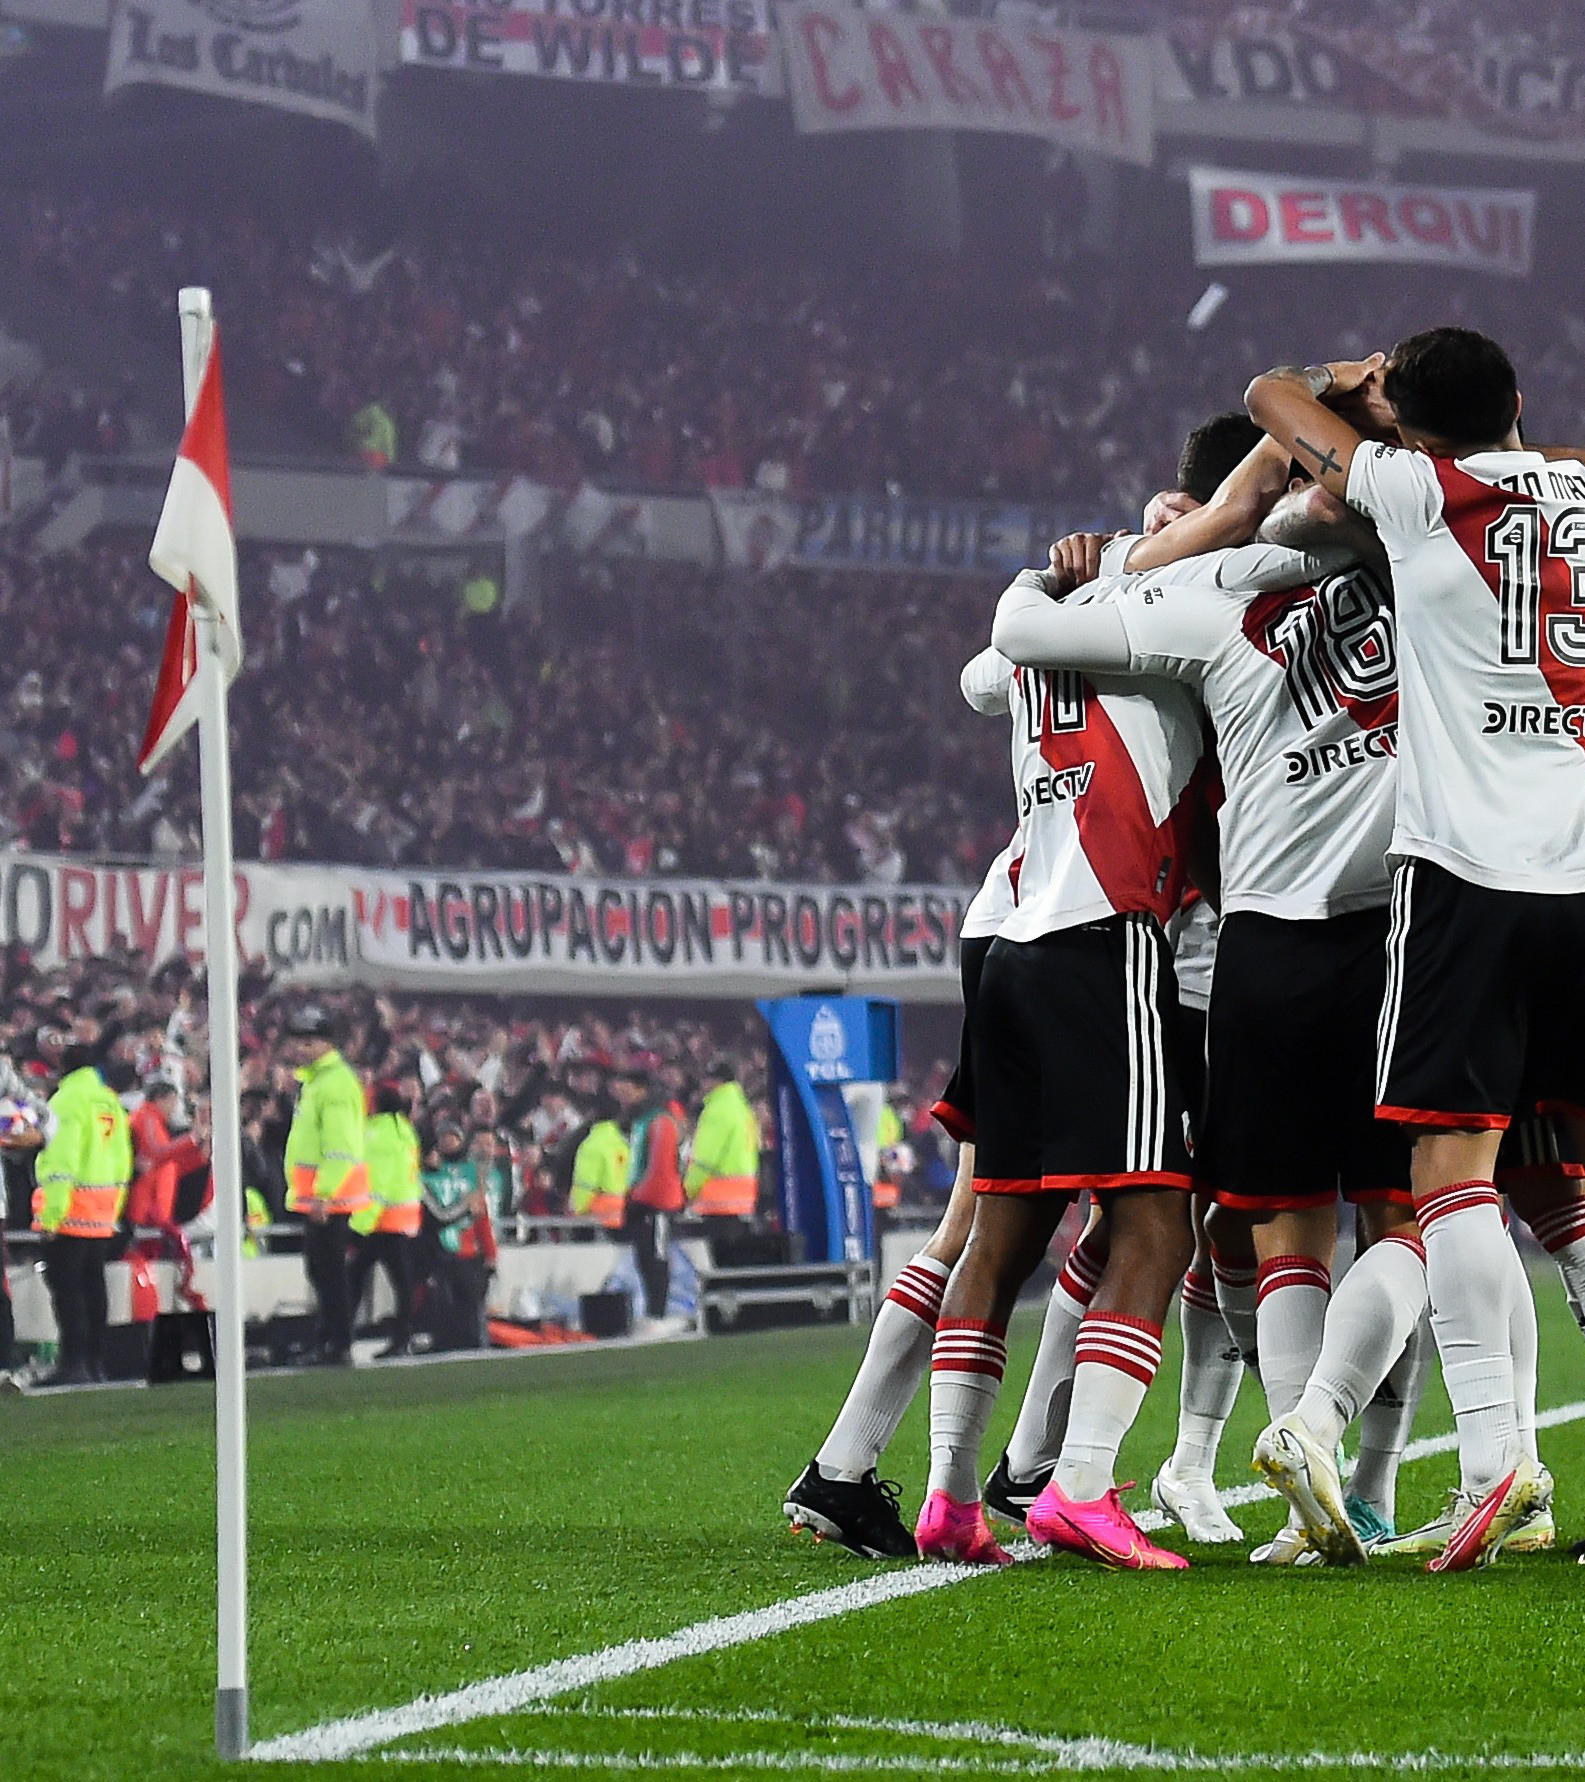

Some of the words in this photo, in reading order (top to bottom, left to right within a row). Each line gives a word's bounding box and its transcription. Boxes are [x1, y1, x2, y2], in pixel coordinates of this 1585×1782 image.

[417, 8, 504, 65] DE
[533, 20, 758, 89] WILDE
[803, 12, 1128, 142] CARAZA
[1211, 187, 1523, 257] DERQUI
[1264, 566, 1399, 732] 18
[408, 881, 712, 963] AGRUPACION
